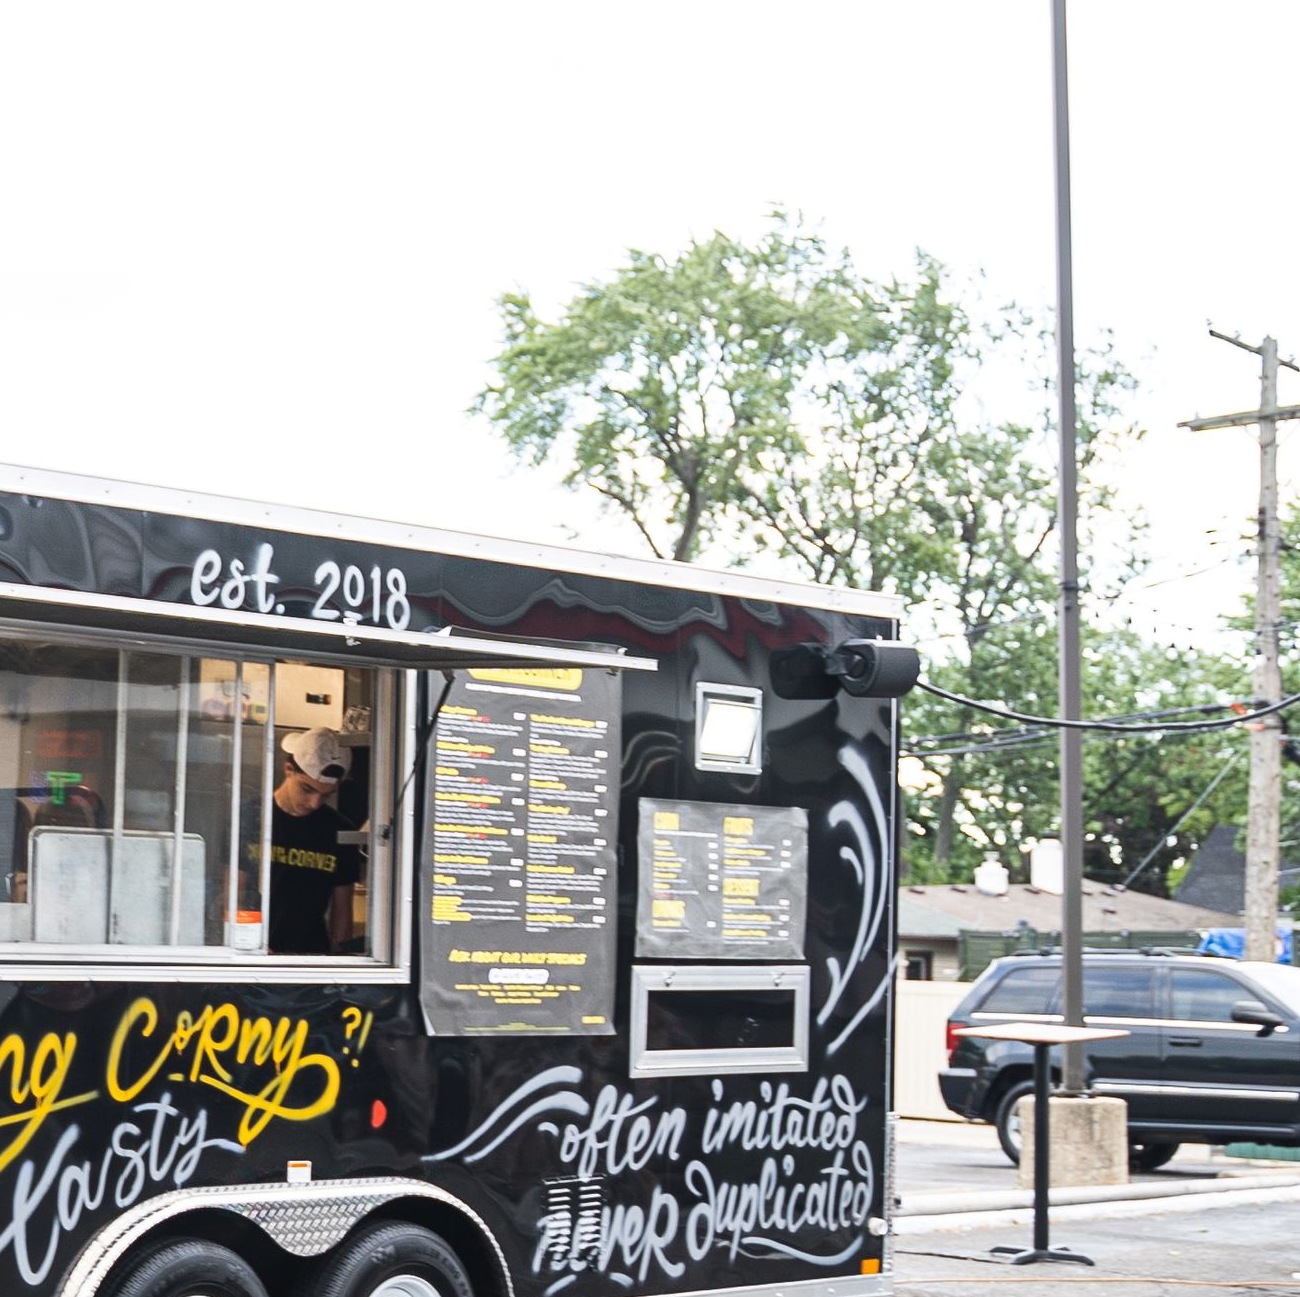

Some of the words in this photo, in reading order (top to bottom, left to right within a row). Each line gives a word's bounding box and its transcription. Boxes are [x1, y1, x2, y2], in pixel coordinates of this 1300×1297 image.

[190, 542, 286, 614] est.
[312, 561, 411, 632] 2018
[558, 1084, 692, 1184] often
[702, 1074, 868, 1155] imitated
[685, 1140, 874, 1264] duplicated
